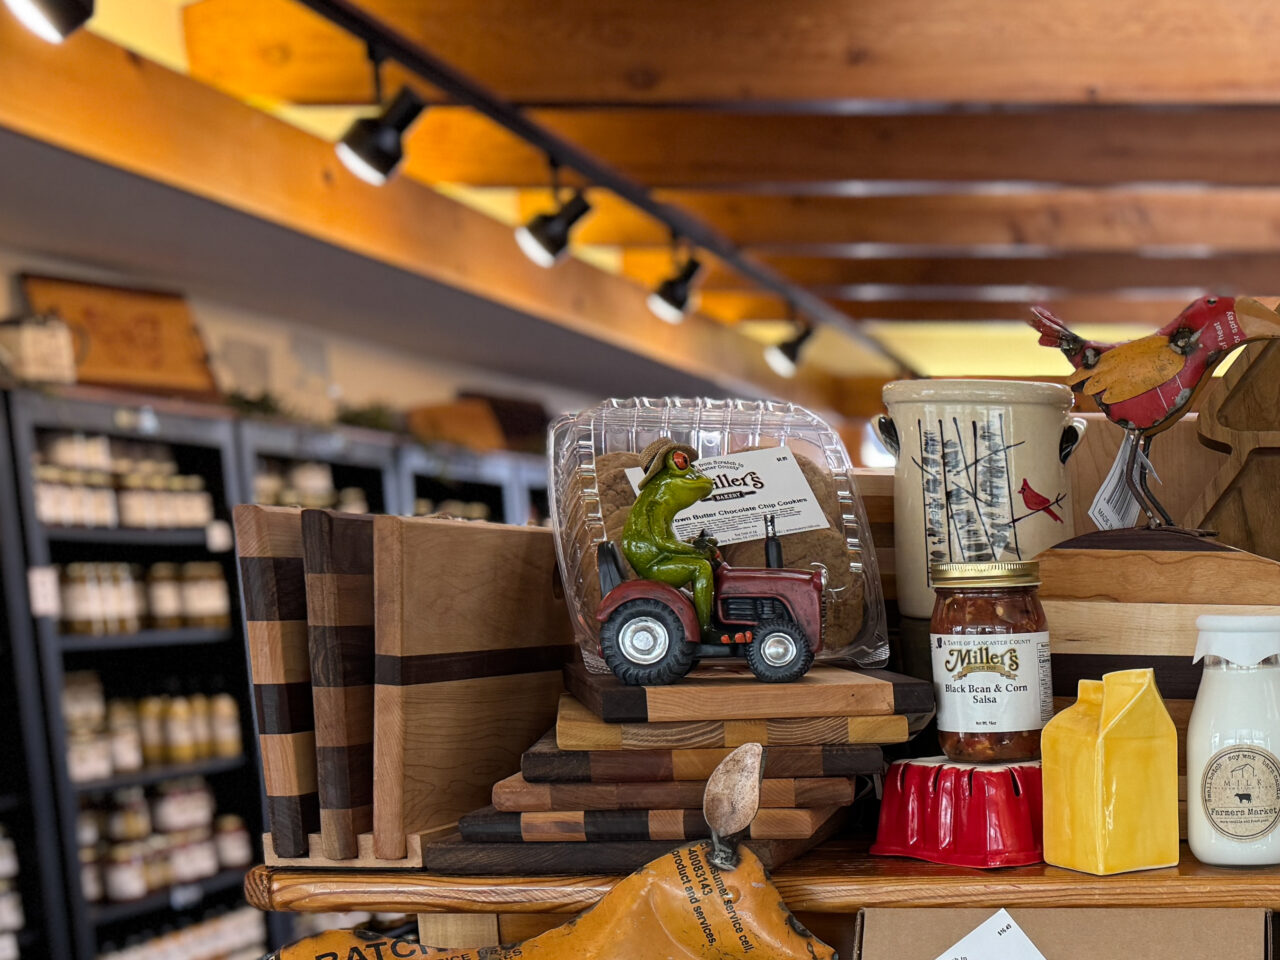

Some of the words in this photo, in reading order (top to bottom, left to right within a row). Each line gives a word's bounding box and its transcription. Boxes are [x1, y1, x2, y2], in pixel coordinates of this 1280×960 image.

[712, 472, 764, 490] iller's
[715, 492, 742, 500] BAKERY
[693, 511, 717, 520] Butter
[718, 504, 756, 517] Chocolate
[758, 502, 776, 511] Chip
[777, 498, 808, 507] Cookies
[945, 647, 1019, 672] Miller's
[945, 684, 966, 693] Black
[994, 684, 1002, 692] &
[1005, 683, 1028, 692] Corn
[972, 695, 997, 704] Salsa
[1262, 759, 1275, 775] barn
[1211, 808, 1245, 816] Farmers
[1247, 807, 1278, 816] Market
[671, 849, 690, 886] product
[684, 885, 700, 905] and
[693, 901, 717, 947] services,
[723, 898, 744, 934] service
